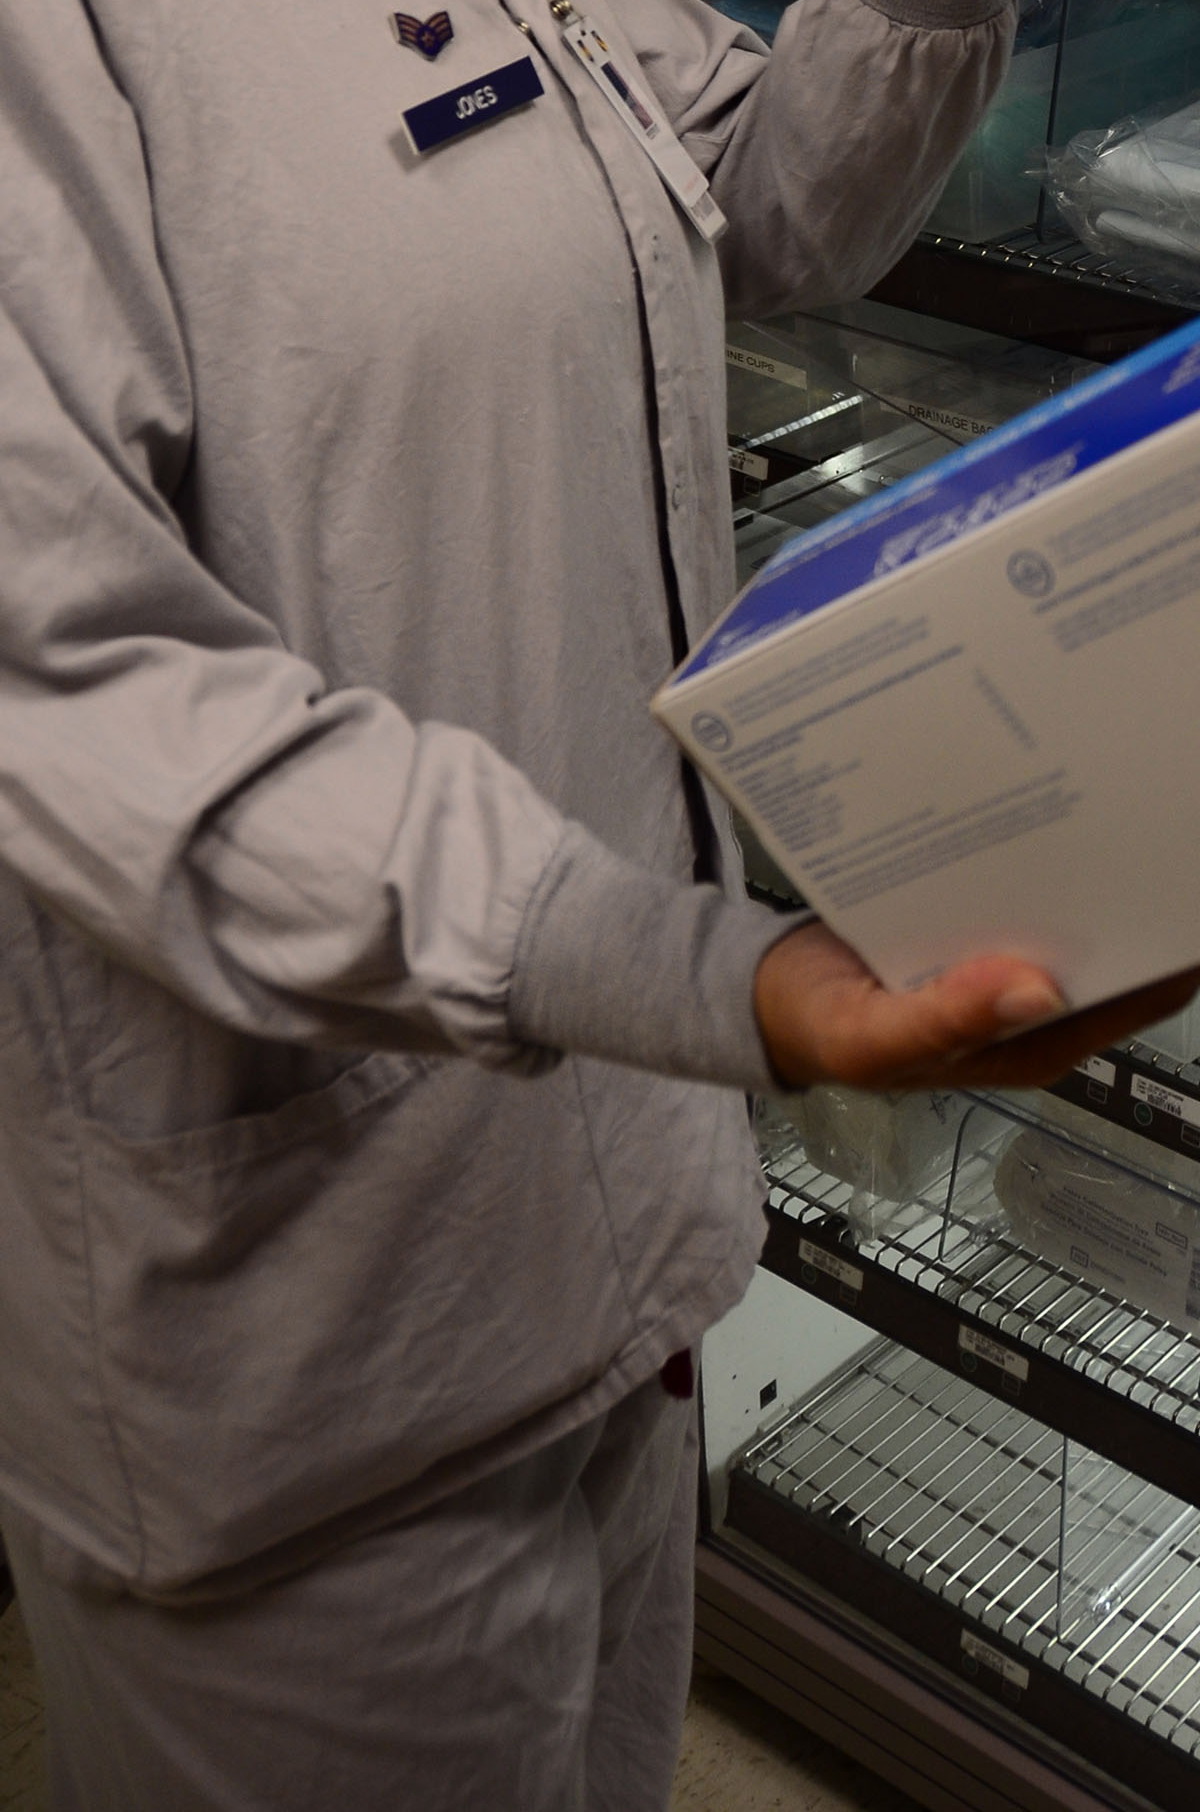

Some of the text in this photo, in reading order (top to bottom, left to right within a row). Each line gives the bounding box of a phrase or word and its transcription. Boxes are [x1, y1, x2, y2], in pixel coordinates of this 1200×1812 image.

[455, 85, 498, 120] JONES
[746, 356, 776, 374] CUPS
[908, 404, 969, 432] DRAINAGE
